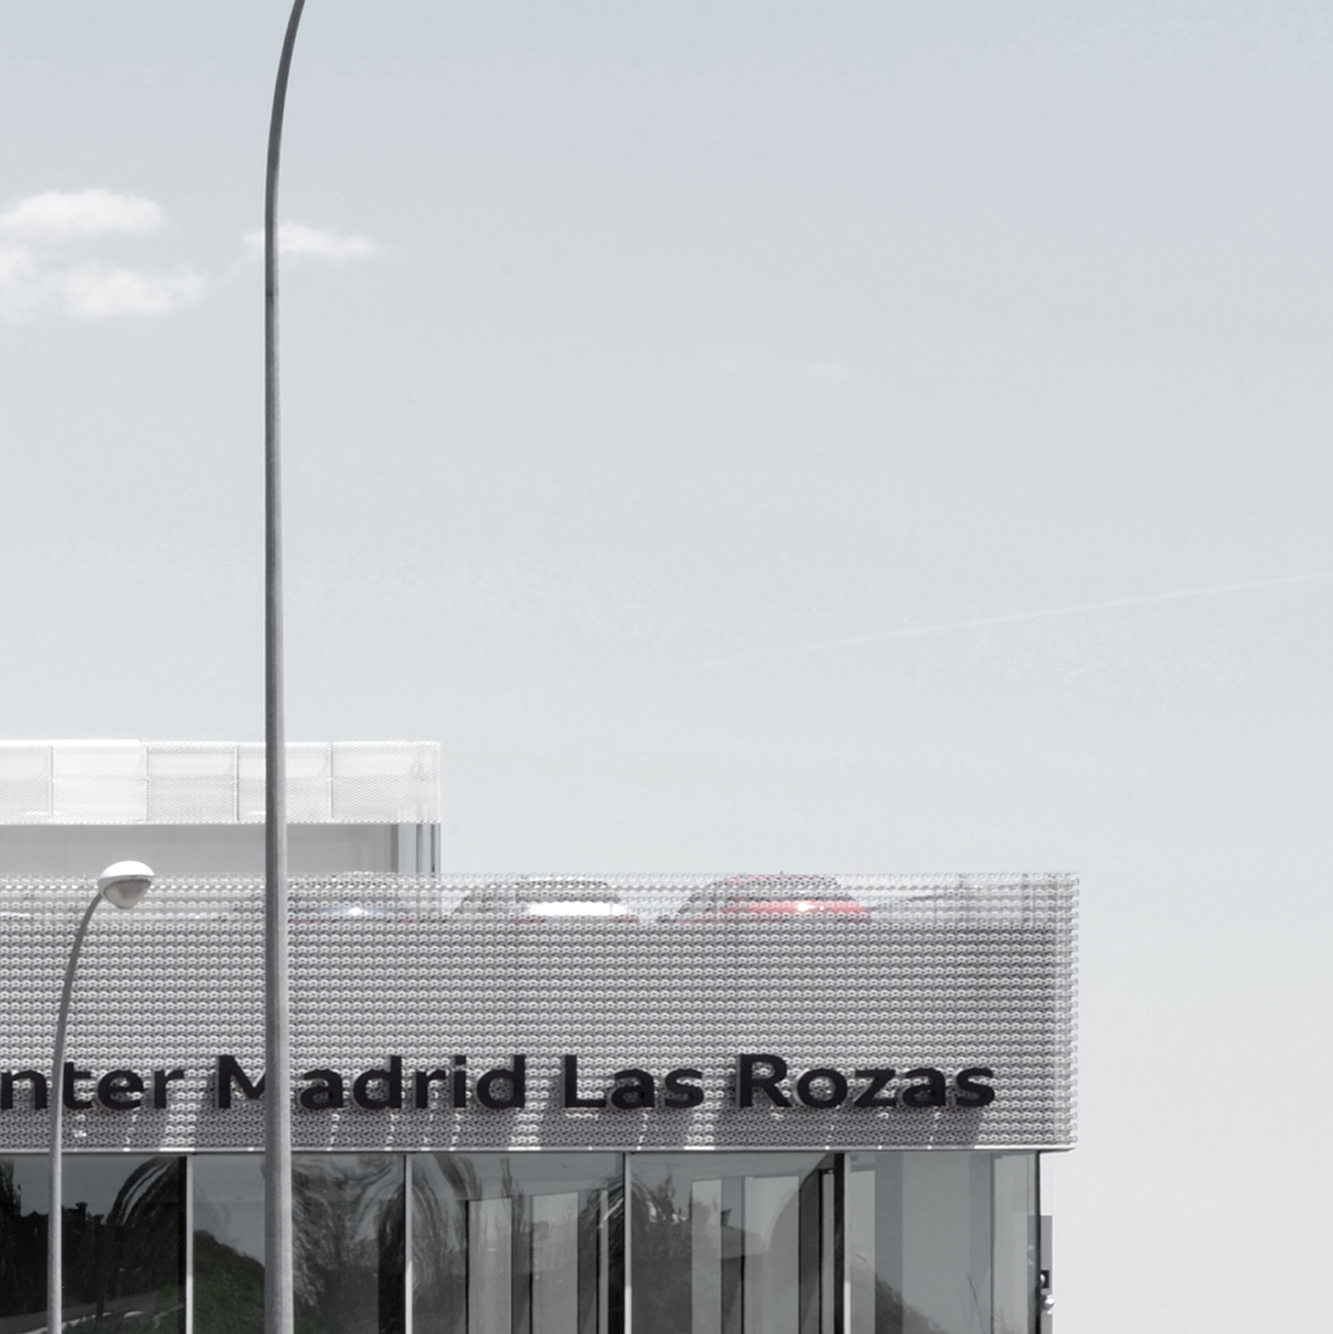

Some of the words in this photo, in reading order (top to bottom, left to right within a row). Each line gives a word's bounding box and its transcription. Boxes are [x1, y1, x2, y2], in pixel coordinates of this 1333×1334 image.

[217, 1053, 527, 1111] Madrid
[563, 1053, 706, 1110] Las
[737, 1052, 997, 1110] Rozas
